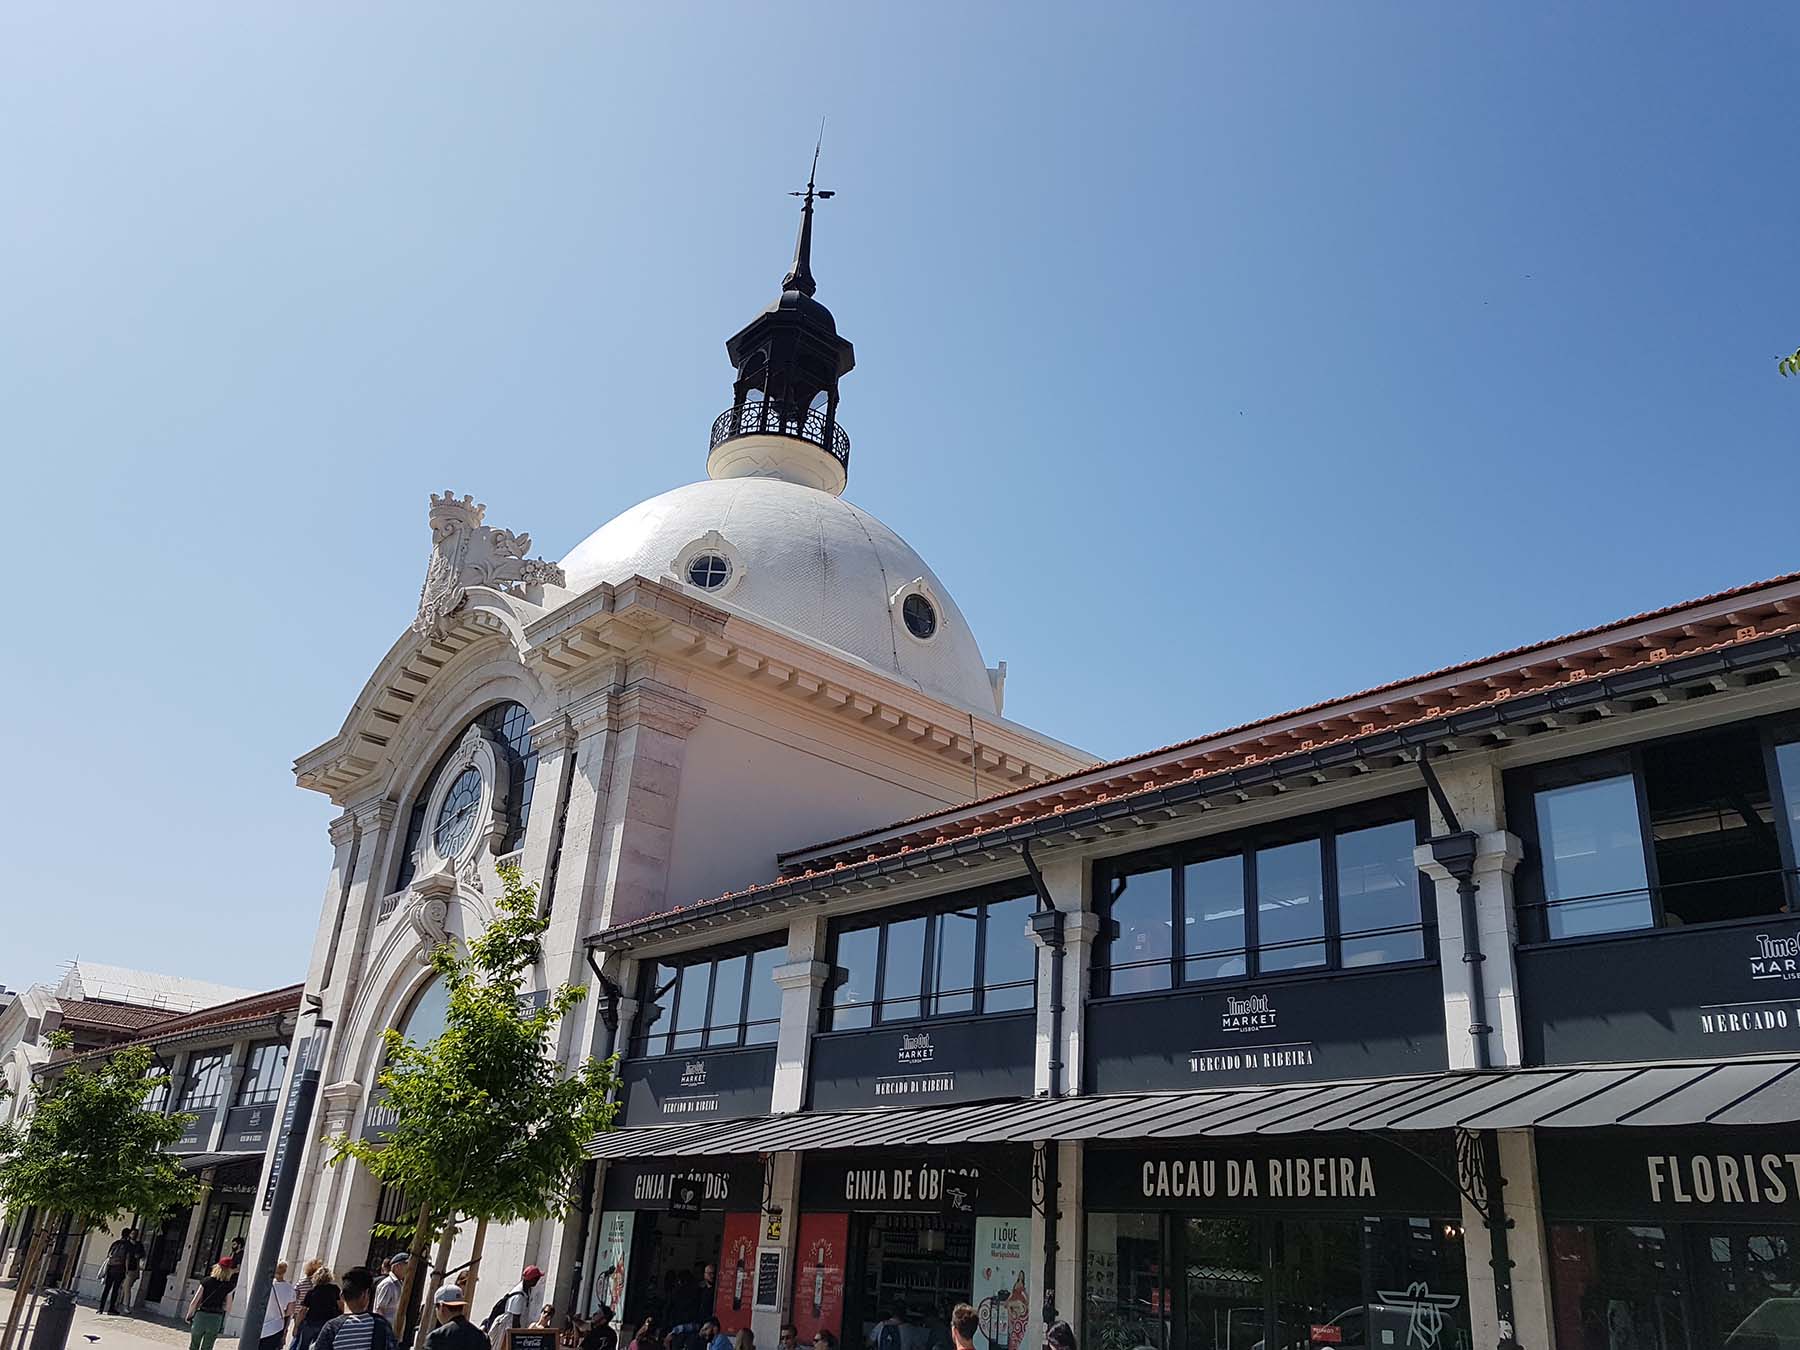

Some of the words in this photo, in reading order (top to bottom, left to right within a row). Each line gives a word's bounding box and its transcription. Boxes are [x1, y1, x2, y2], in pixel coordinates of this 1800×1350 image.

[1756, 931, 1800, 959] Time
[1222, 1013, 1277, 1028] MARKET
[1701, 1009, 1788, 1034] MERCADO
[898, 1048, 934, 1060] MARKET
[1189, 1055, 1241, 1073] MERCADO
[1245, 1053, 1258, 1069] DA
[1263, 1049, 1313, 1068] RIBEIRA
[680, 1073, 706, 1083] MARKET
[875, 1081, 908, 1096] MERCADO
[910, 1080, 919, 1094] DA
[922, 1078, 954, 1093] RIBEIRA
[634, 1173, 665, 1200] GINJA
[845, 1168, 887, 1200] GINJA
[893, 1168, 913, 1200] DE
[1142, 1159, 1216, 1198] CACAU
[1226, 1158, 1259, 1198] DA
[1268, 1156, 1377, 1198] RIBEIRA
[998, 1227, 1018, 1242] LOVE
